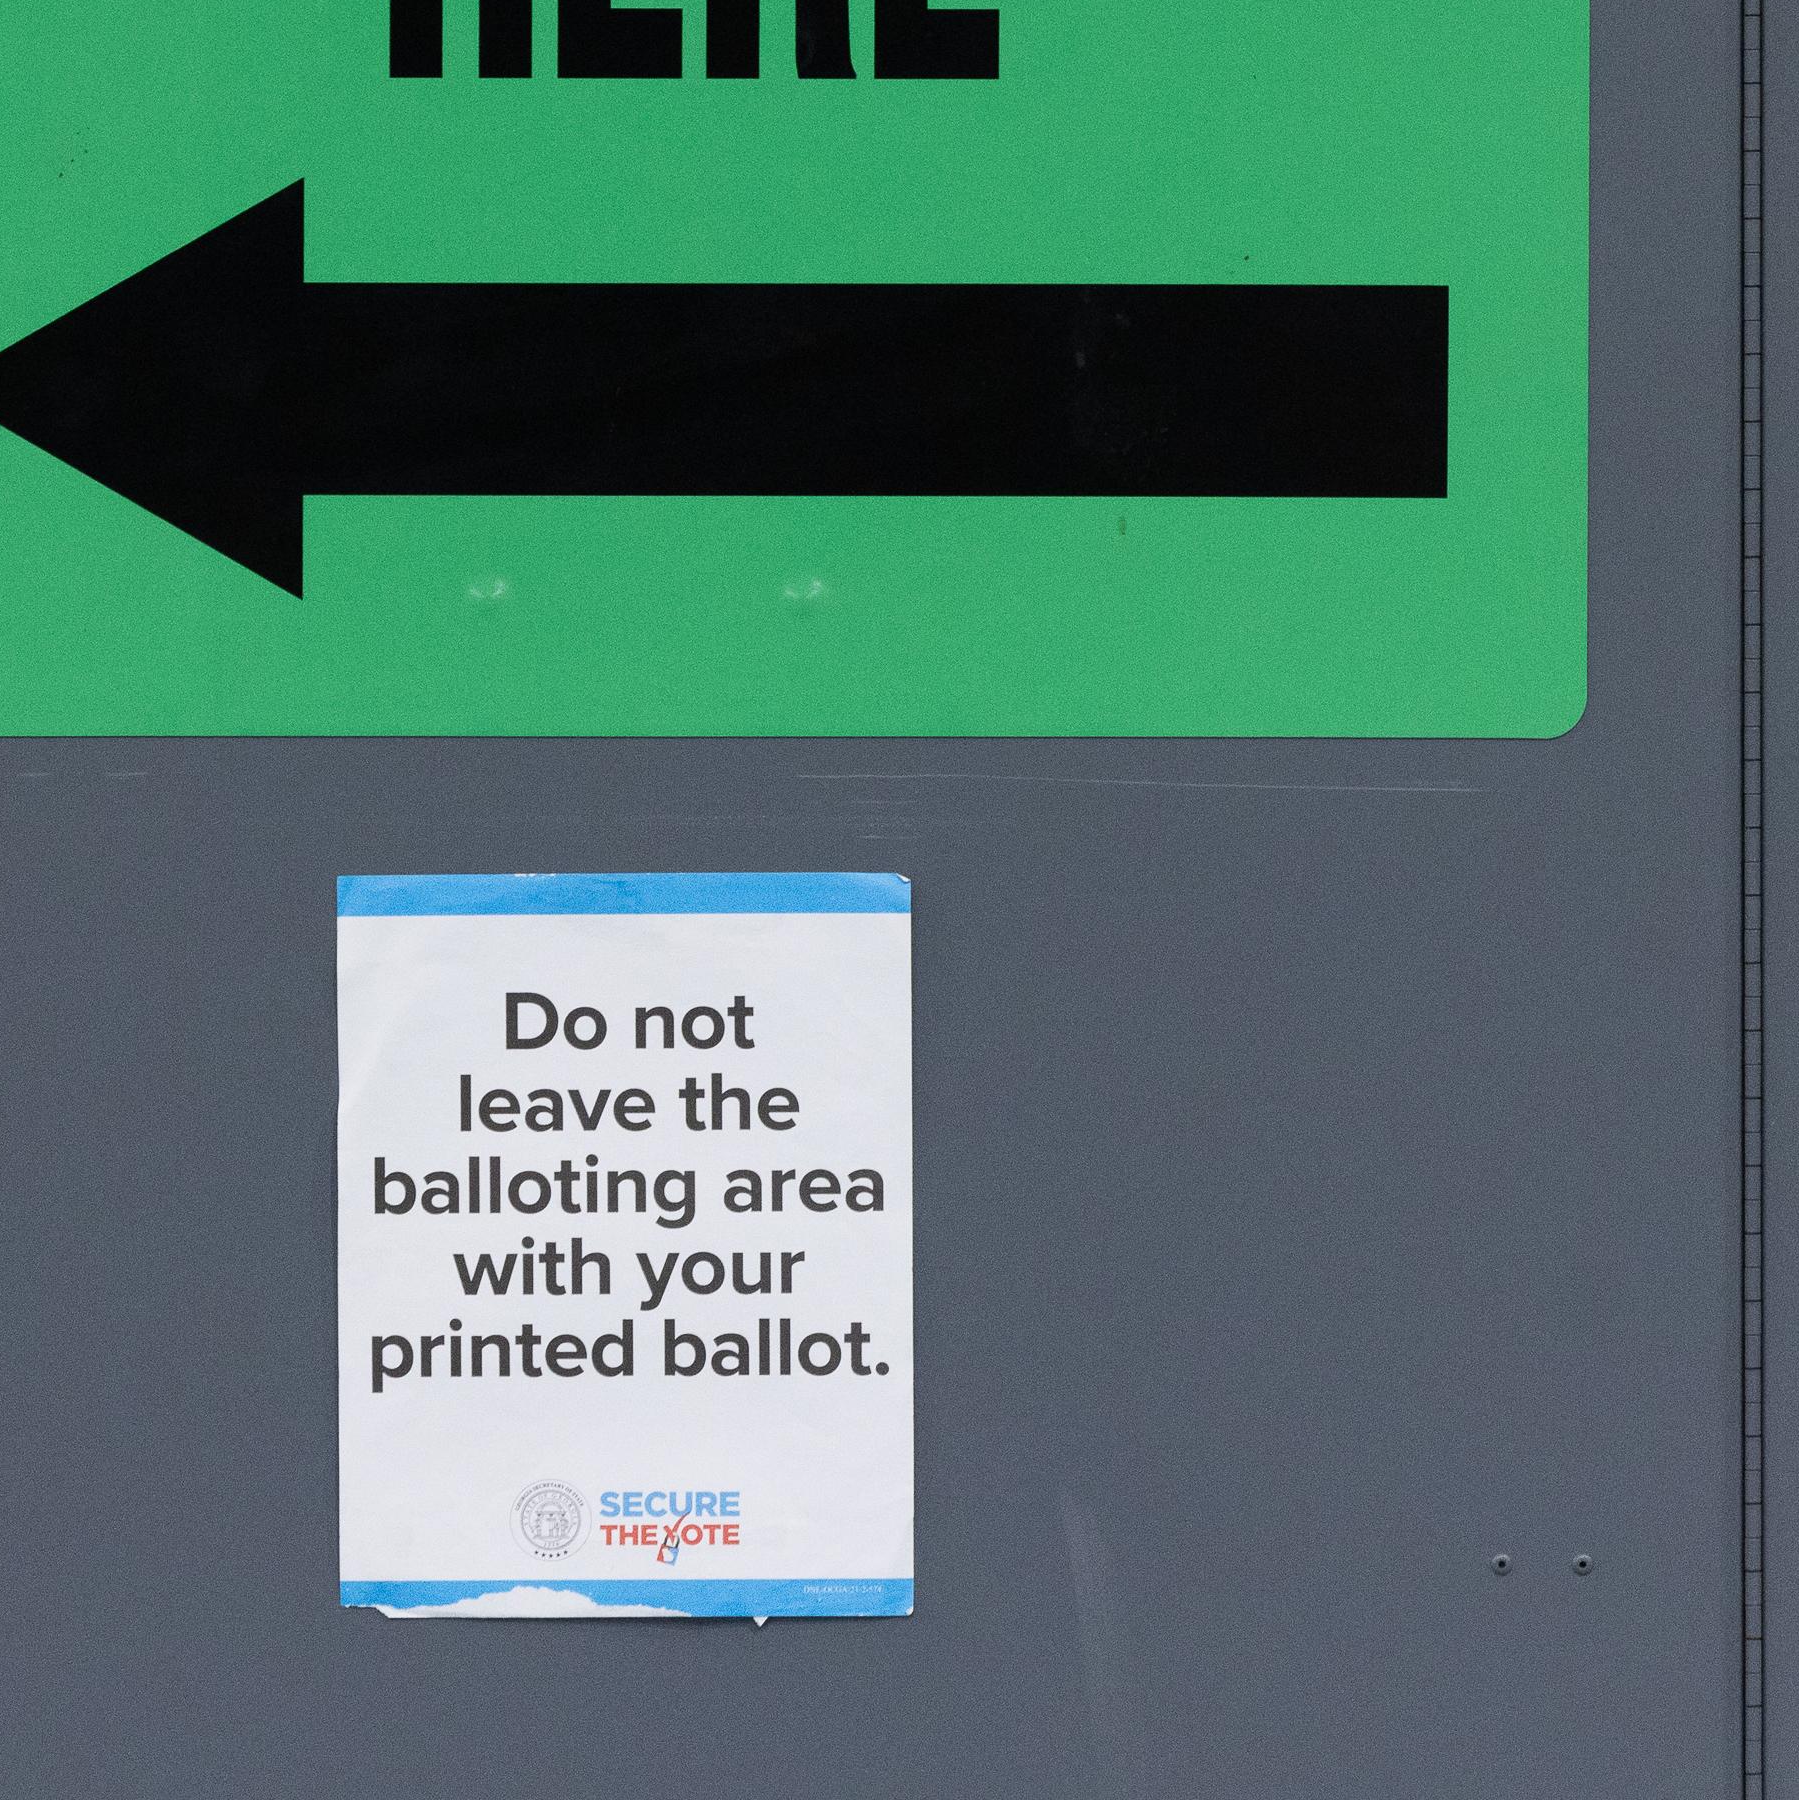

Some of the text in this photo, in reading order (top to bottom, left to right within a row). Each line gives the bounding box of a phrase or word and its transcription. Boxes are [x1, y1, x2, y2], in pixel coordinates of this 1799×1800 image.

[505, 992, 755, 1051] Do not
[460, 1072, 800, 1133] leave the
[374, 1153, 885, 1229] balloting area
[453, 1236, 805, 1311] with your
[371, 1318, 891, 1394] printed ballot.
[600, 1491, 741, 1517] SECURE
[600, 1524, 658, 1546] THE
